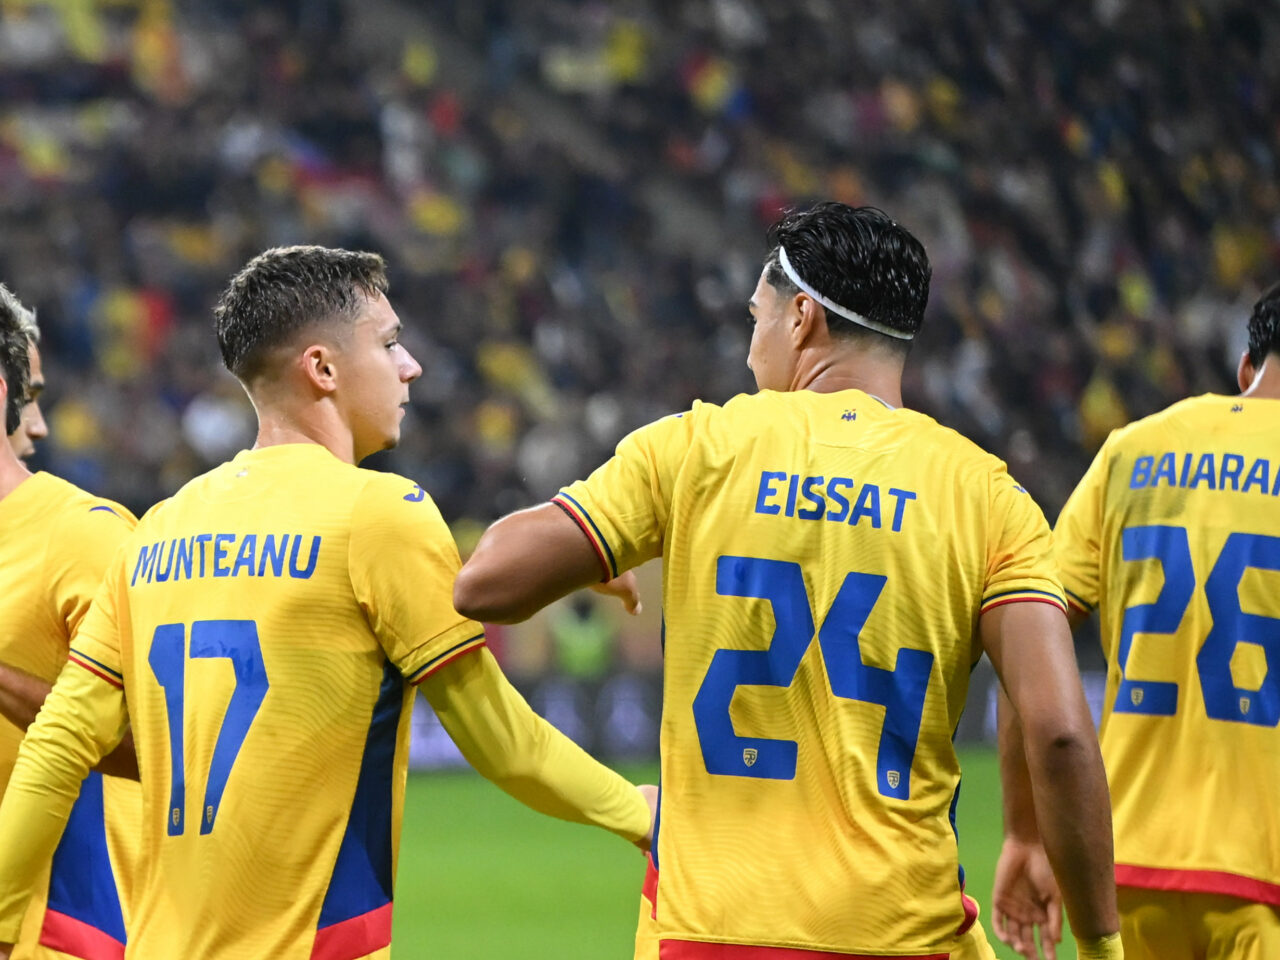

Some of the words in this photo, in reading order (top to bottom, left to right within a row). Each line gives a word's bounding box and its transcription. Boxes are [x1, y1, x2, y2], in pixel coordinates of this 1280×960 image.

[131, 533, 322, 586] MUNTEANU
[755, 471, 917, 532] EISSAT
[148, 619, 270, 836] 17
[692, 555, 934, 801] 24
[1113, 524, 1280, 728] 26
